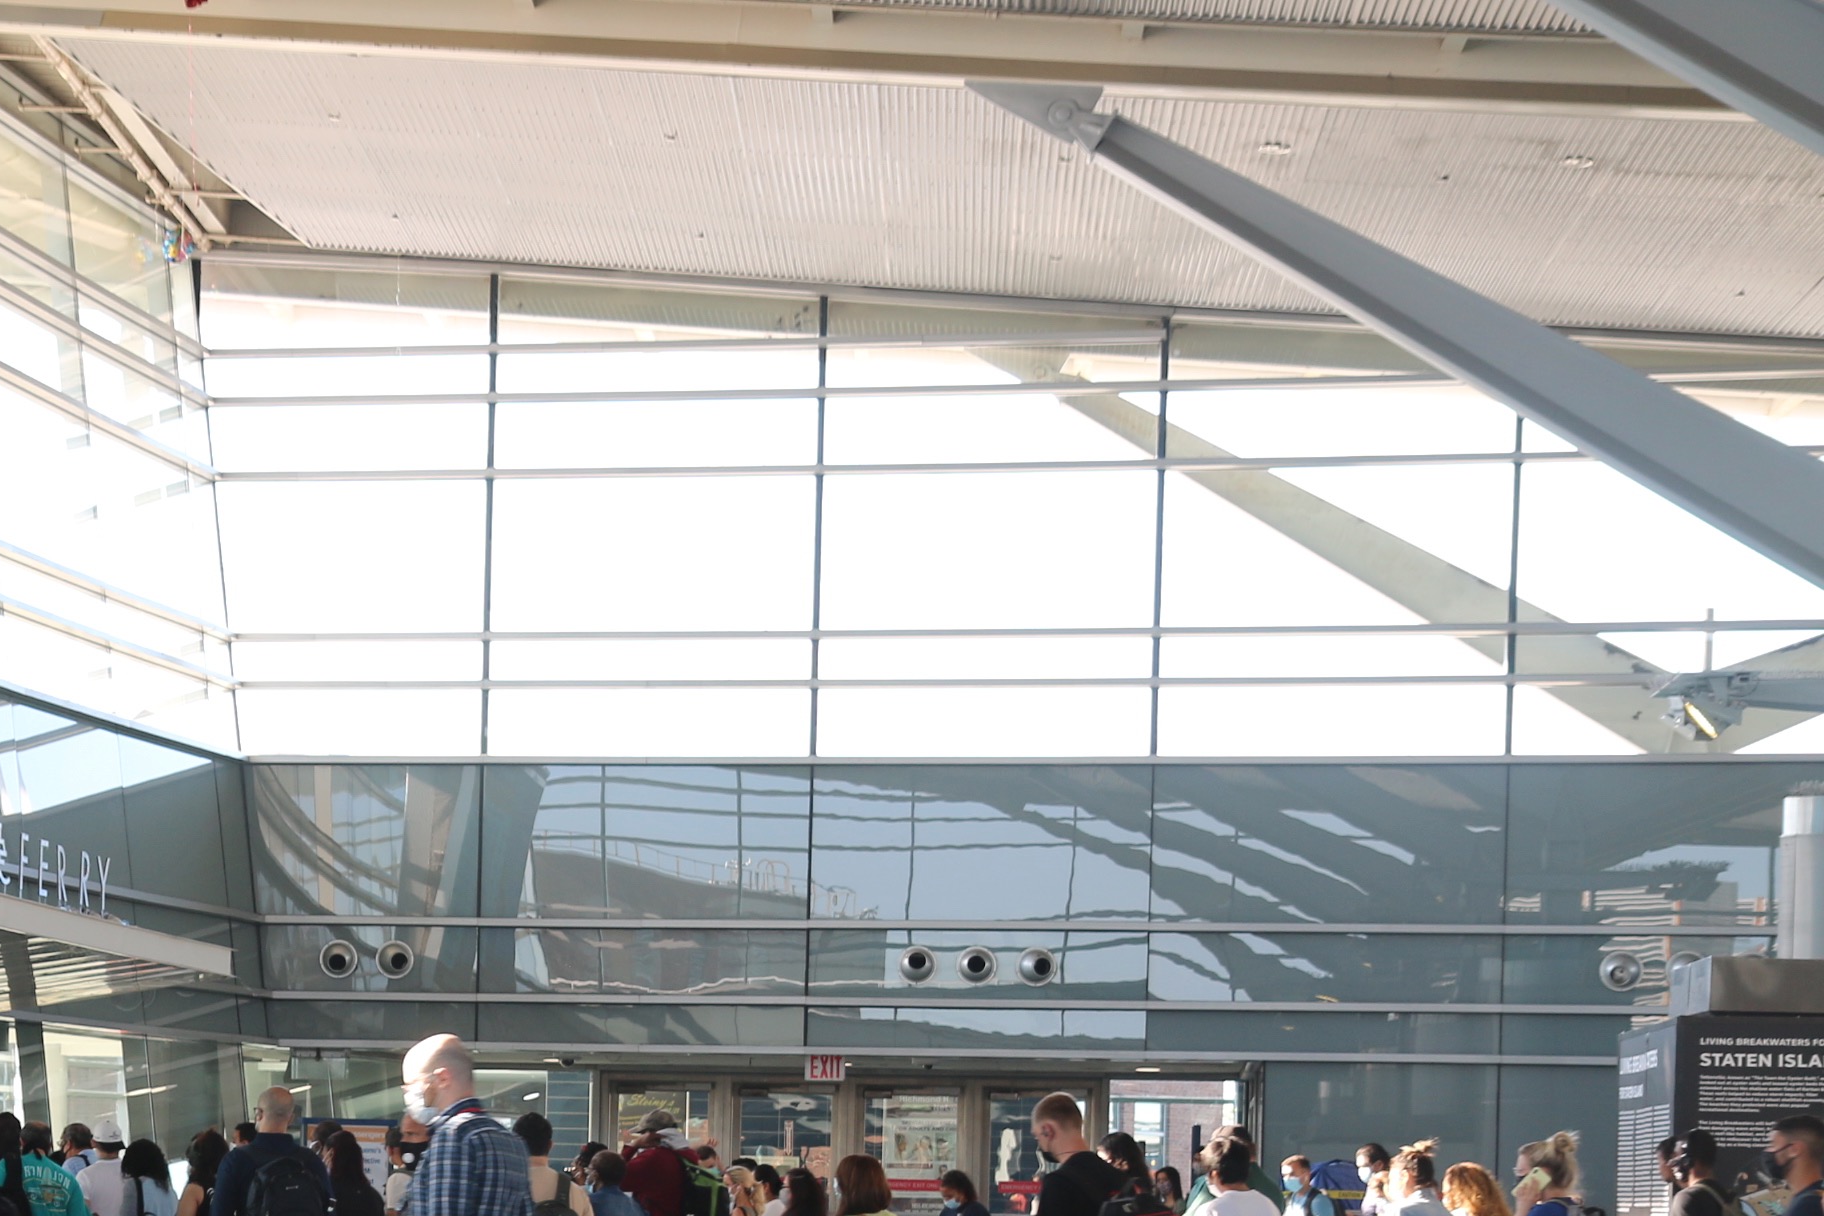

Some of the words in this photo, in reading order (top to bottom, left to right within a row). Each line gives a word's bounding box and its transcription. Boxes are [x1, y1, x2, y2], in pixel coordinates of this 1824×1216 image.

[19, 832, 111, 911] FERRY
[1699, 1037, 1734, 1046] LIVING
[1735, 1037, 1811, 1047] BREAKWATERS
[1812, 1038, 1824, 1047] FO
[810, 1055, 843, 1079] EXIT
[1699, 1052, 1773, 1068] STATEN
[1778, 1053, 1824, 1068] ISLA
